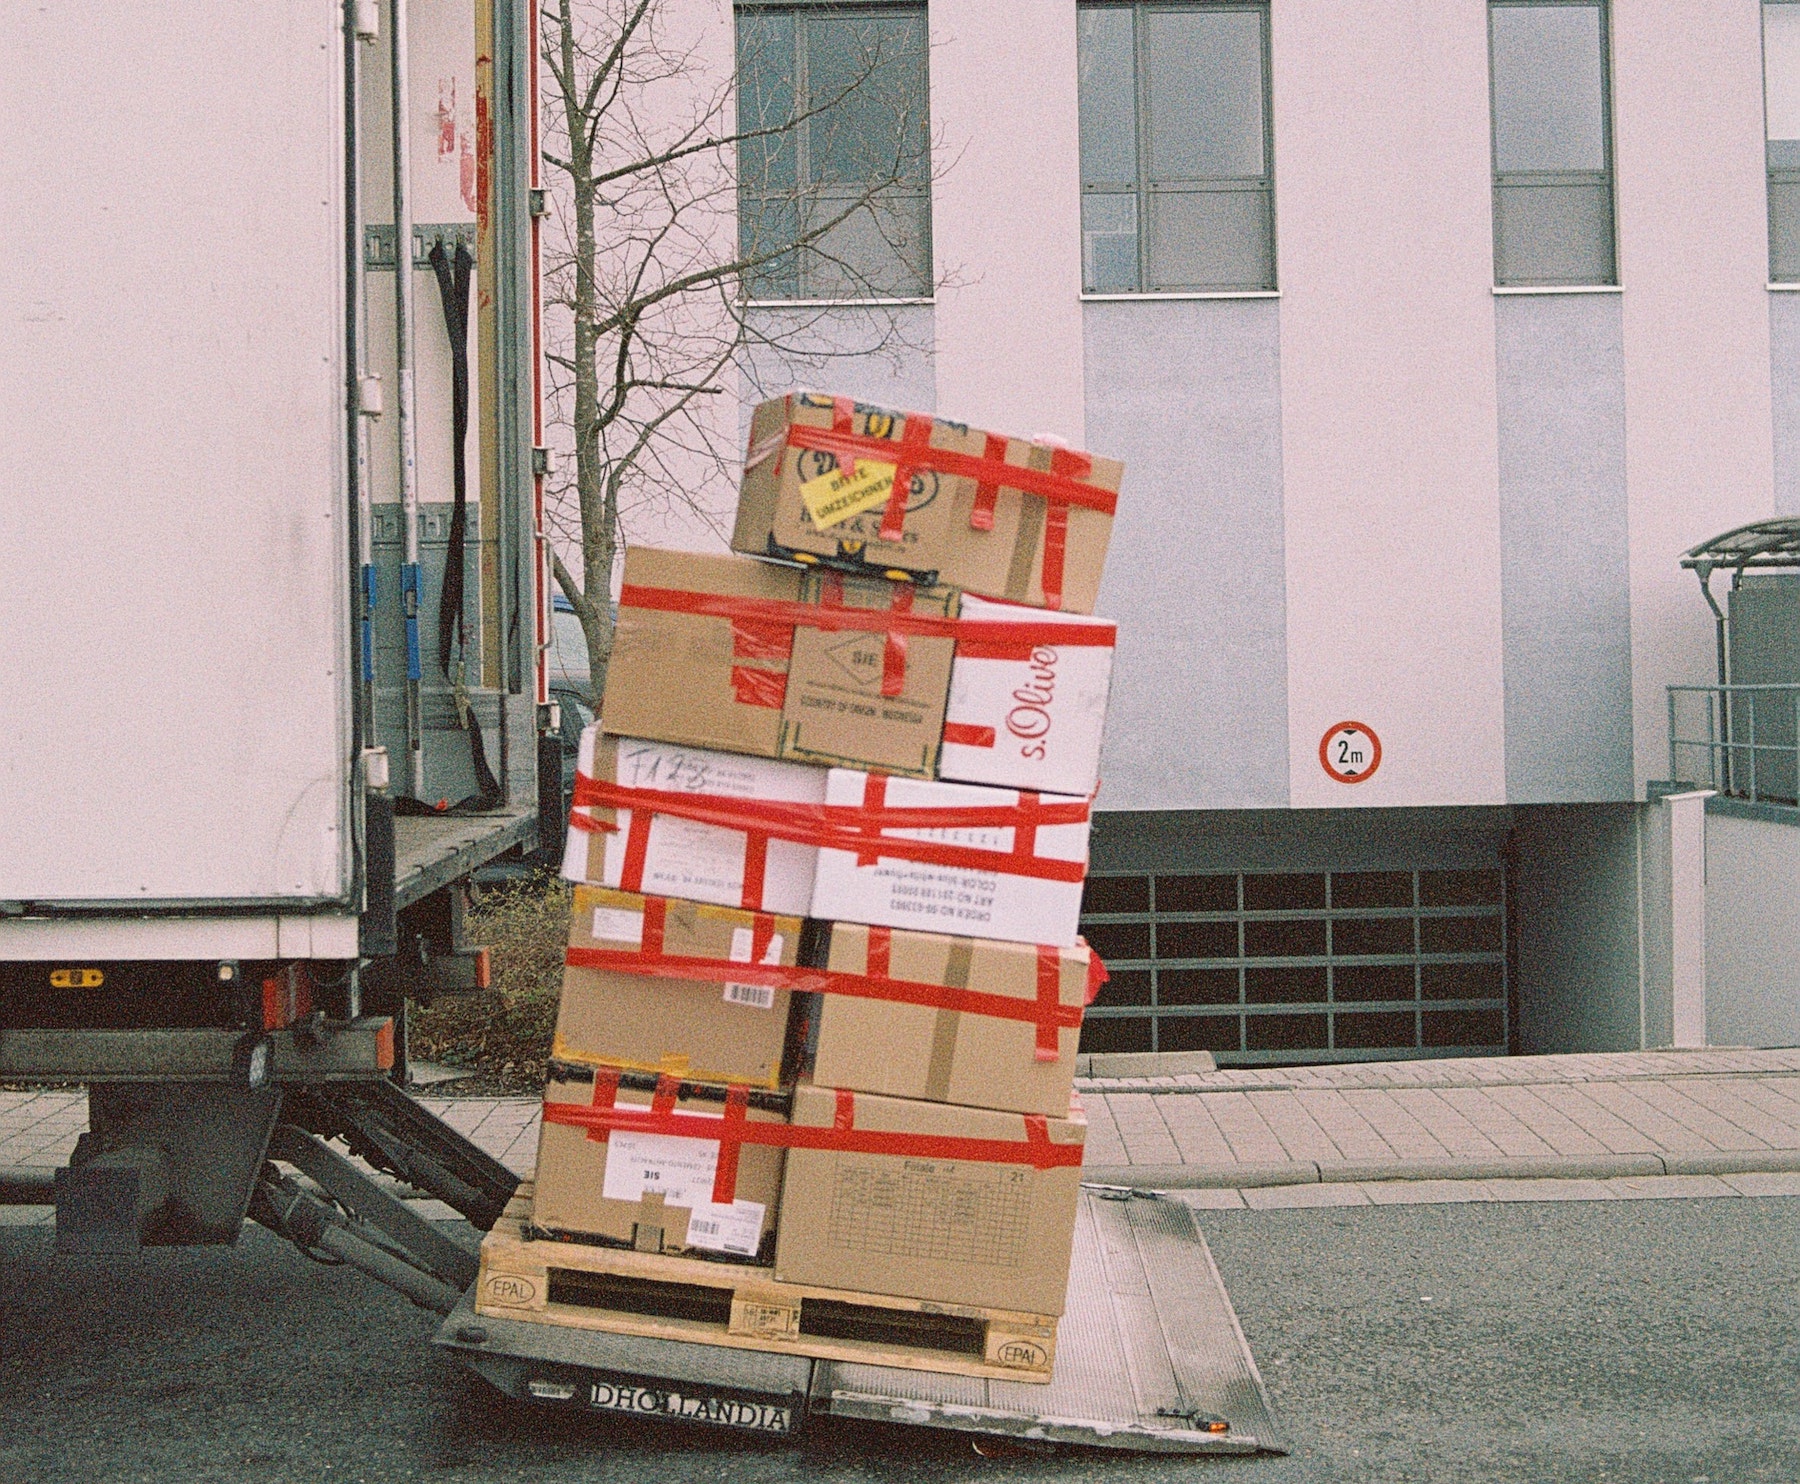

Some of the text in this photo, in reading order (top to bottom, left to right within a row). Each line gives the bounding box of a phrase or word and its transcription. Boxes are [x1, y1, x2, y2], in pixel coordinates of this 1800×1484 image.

[1005, 645, 1058, 761] s.Olive
[1338, 740, 1363, 764] 2m
[962, 877, 996, 892] COLOR
[957, 906, 991, 922] ORDER
[643, 1169, 661, 1181] SIE
[493, 1280, 526, 1299] EPAL
[592, 1383, 788, 1432] DHOLLANDIA
